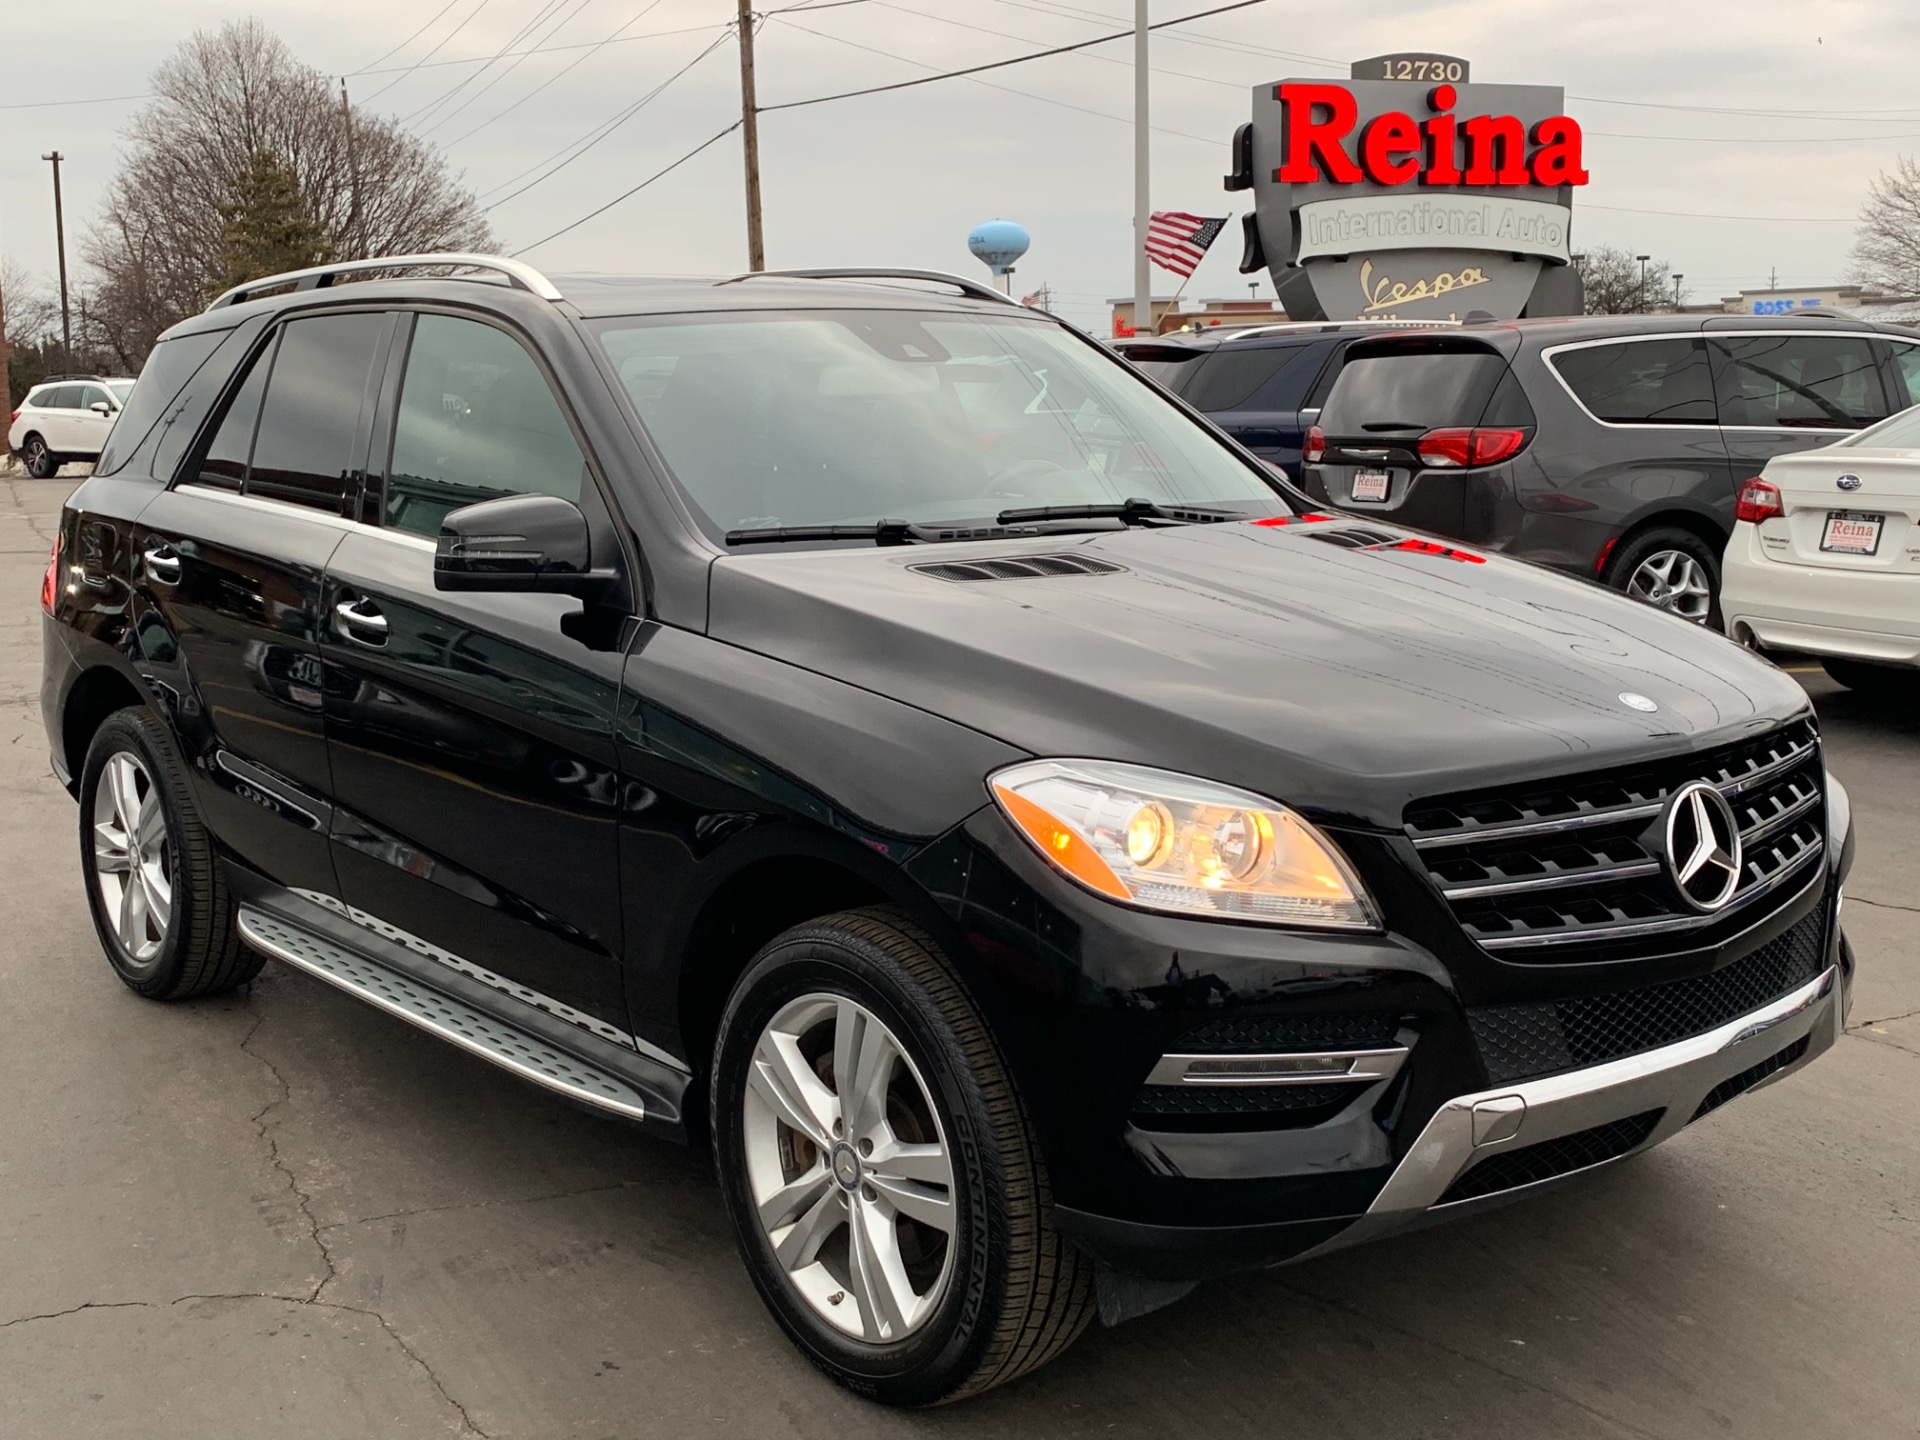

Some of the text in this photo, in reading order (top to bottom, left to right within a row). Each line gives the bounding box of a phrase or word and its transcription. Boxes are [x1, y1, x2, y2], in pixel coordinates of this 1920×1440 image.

[1382, 60, 1463, 82] 12730
[1274, 83, 1589, 186] Reina
[1308, 202, 1563, 247] International Auto
[1359, 258, 1492, 313] Vespa
[1356, 474, 1384, 488] Reina
[1830, 520, 1874, 537] Reina
[952, 1113, 988, 1342] CONTINENTAL
